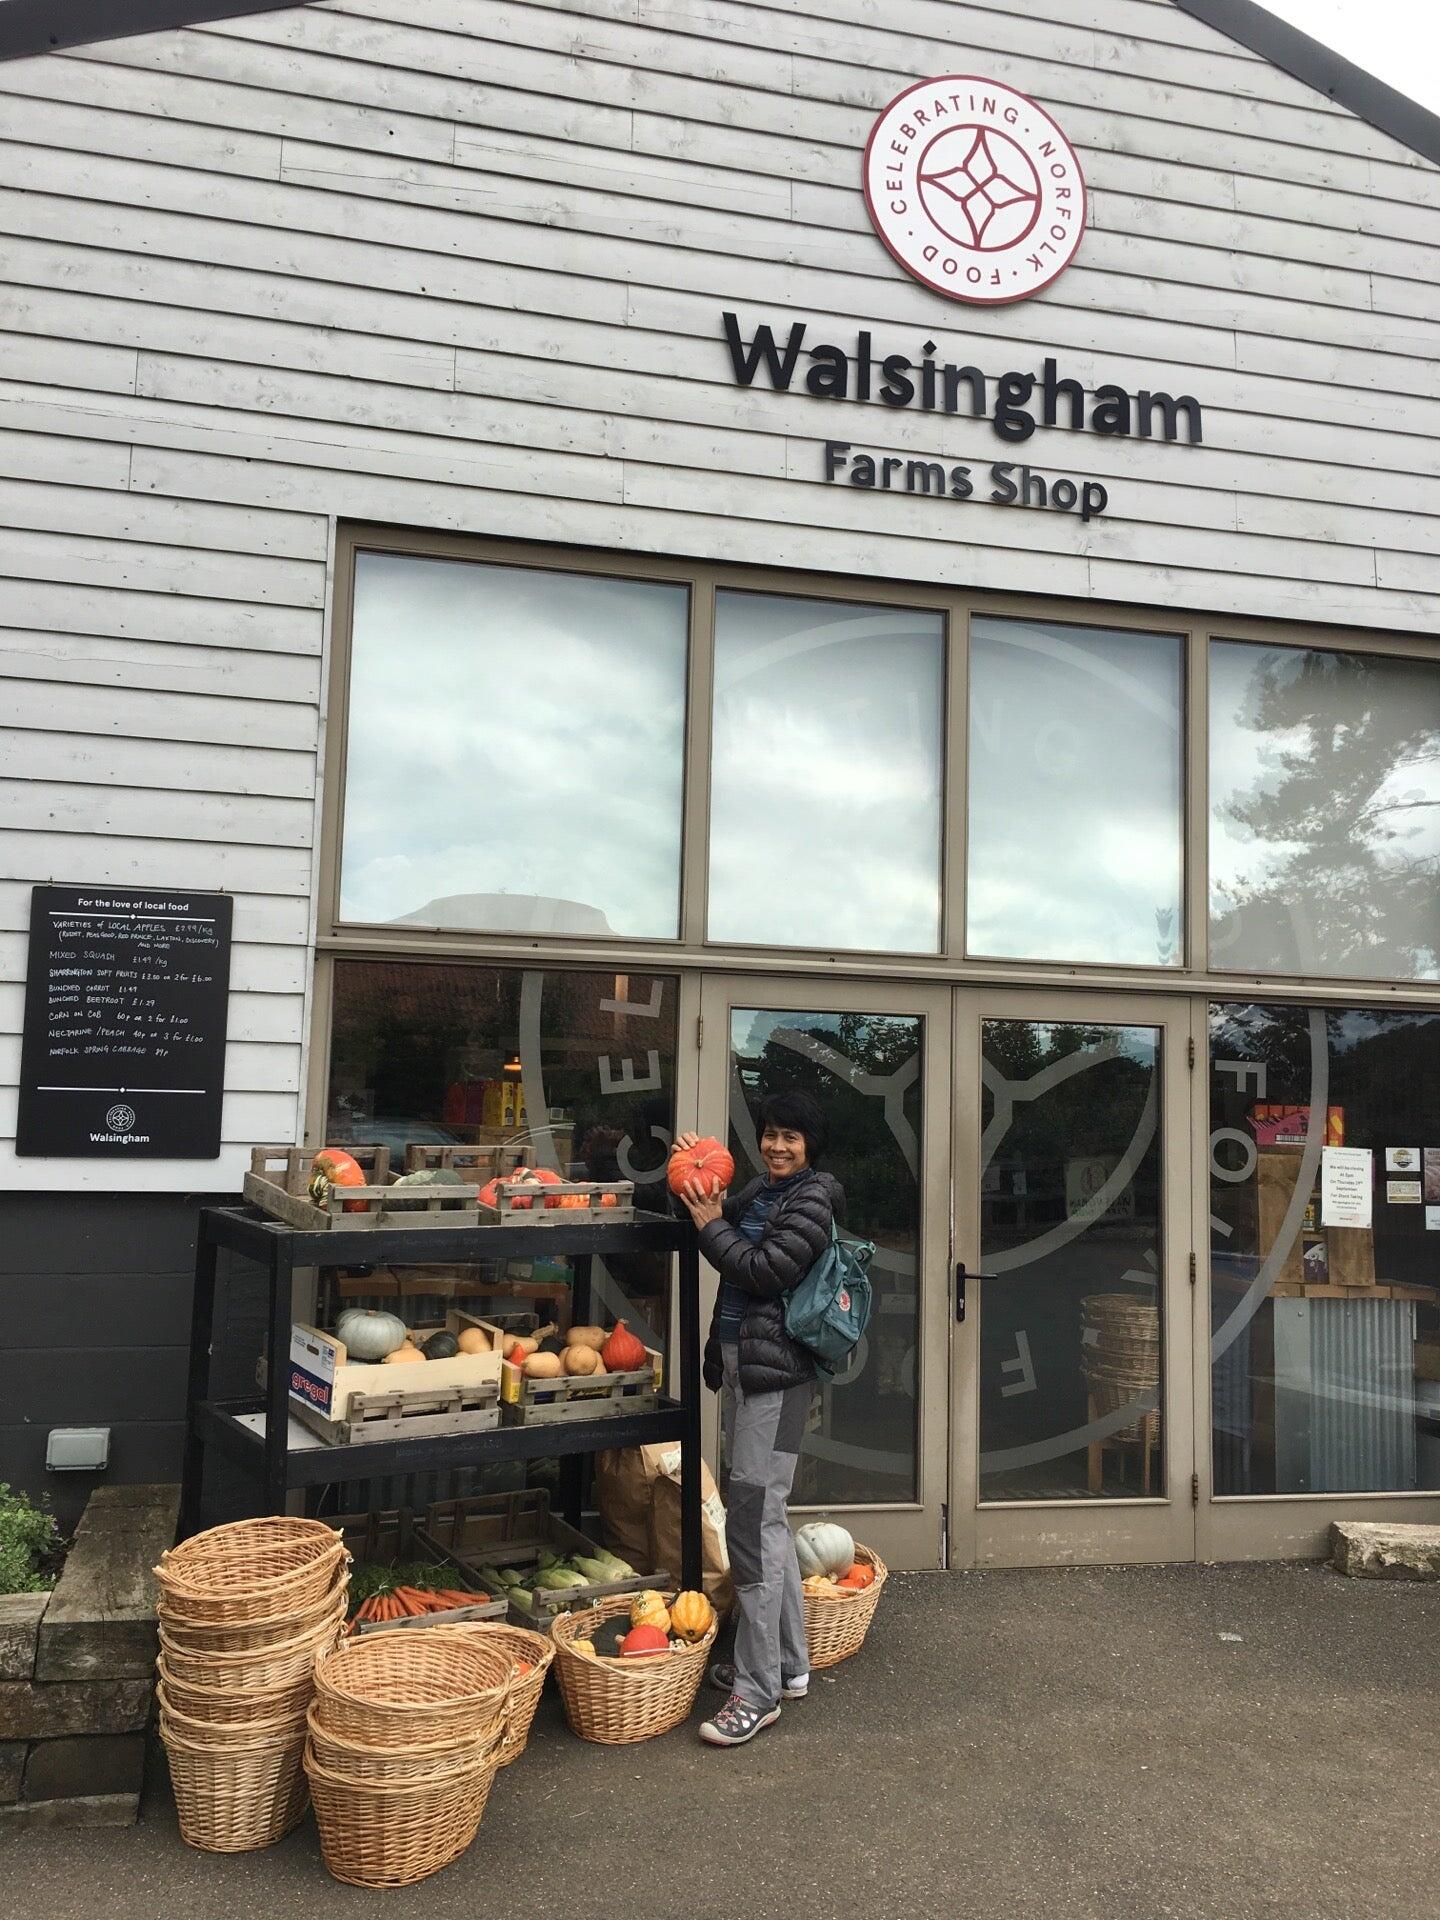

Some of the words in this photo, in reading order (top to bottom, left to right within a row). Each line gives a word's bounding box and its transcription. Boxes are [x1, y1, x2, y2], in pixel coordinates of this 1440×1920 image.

[886, 94, 1020, 215] CELEBRATING
[1029, 141, 1072, 271] NORFOLK
[923, 244, 1002, 285] FOOD
[722, 311, 1203, 443] Walsingham
[825, 440, 973, 498] Farms
[990, 462, 1108, 522] Shop
[78, 898, 92, 906] For
[95, 899, 109, 907] the
[112, 900, 130, 909] love
[133, 901, 142, 909] of
[145, 902, 165, 910] local
[168, 903, 189, 911] food
[108, 921, 131, 931] LOCAL
[134, 923, 166, 932] APPLES
[50, 951, 76, 959] MIXED
[83, 951, 115, 961] SQUASH
[97, 969, 112, 977] SOFT
[115, 970, 138, 979] FRUITS
[49, 984, 80, 992] BUNCHED
[48, 995, 79, 1004] BUNCHED
[86, 995, 124, 1004] BEETROOT
[49, 1011, 70, 1021] CORN
[88, 1010, 101, 1019] COB
[49, 1028, 92, 1038] NECTARINE
[164, 1032, 169, 1040] 3
[50, 1047, 79, 1056] NORFOLK
[84, 1045, 108, 1054] SPRING
[90, 1132, 150, 1144] Walsingham
[292, 1371, 329, 1405] gregal
